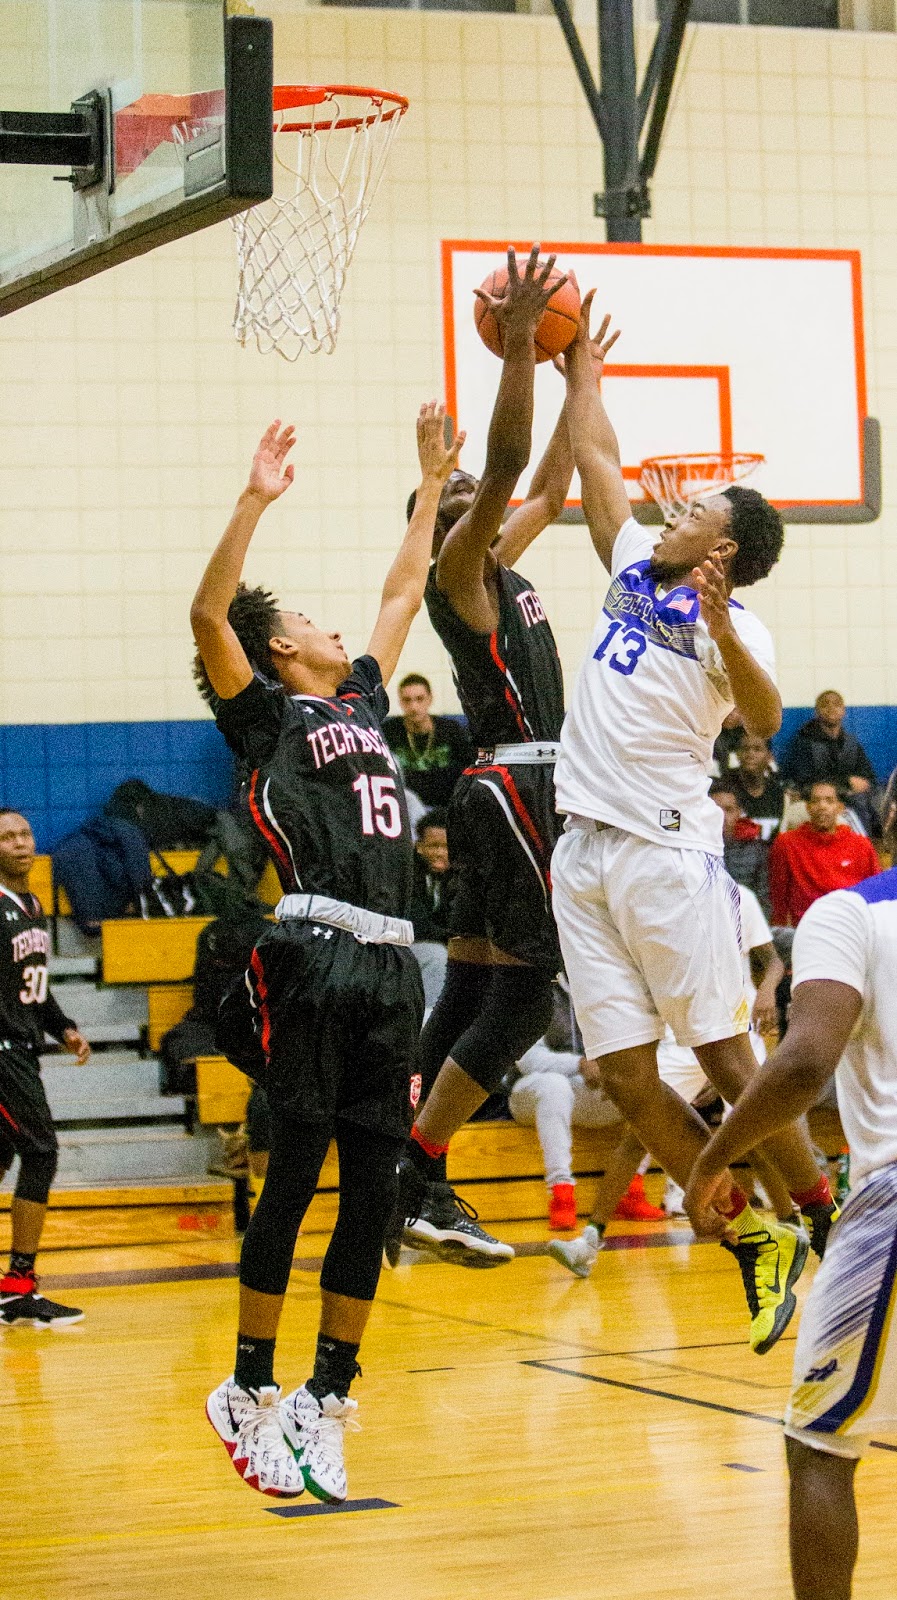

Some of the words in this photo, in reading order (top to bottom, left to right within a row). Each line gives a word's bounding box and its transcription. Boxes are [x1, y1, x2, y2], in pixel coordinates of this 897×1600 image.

[592, 620, 648, 676] 13
[353, 773, 402, 838] 15
[20, 965, 48, 1004] 30
